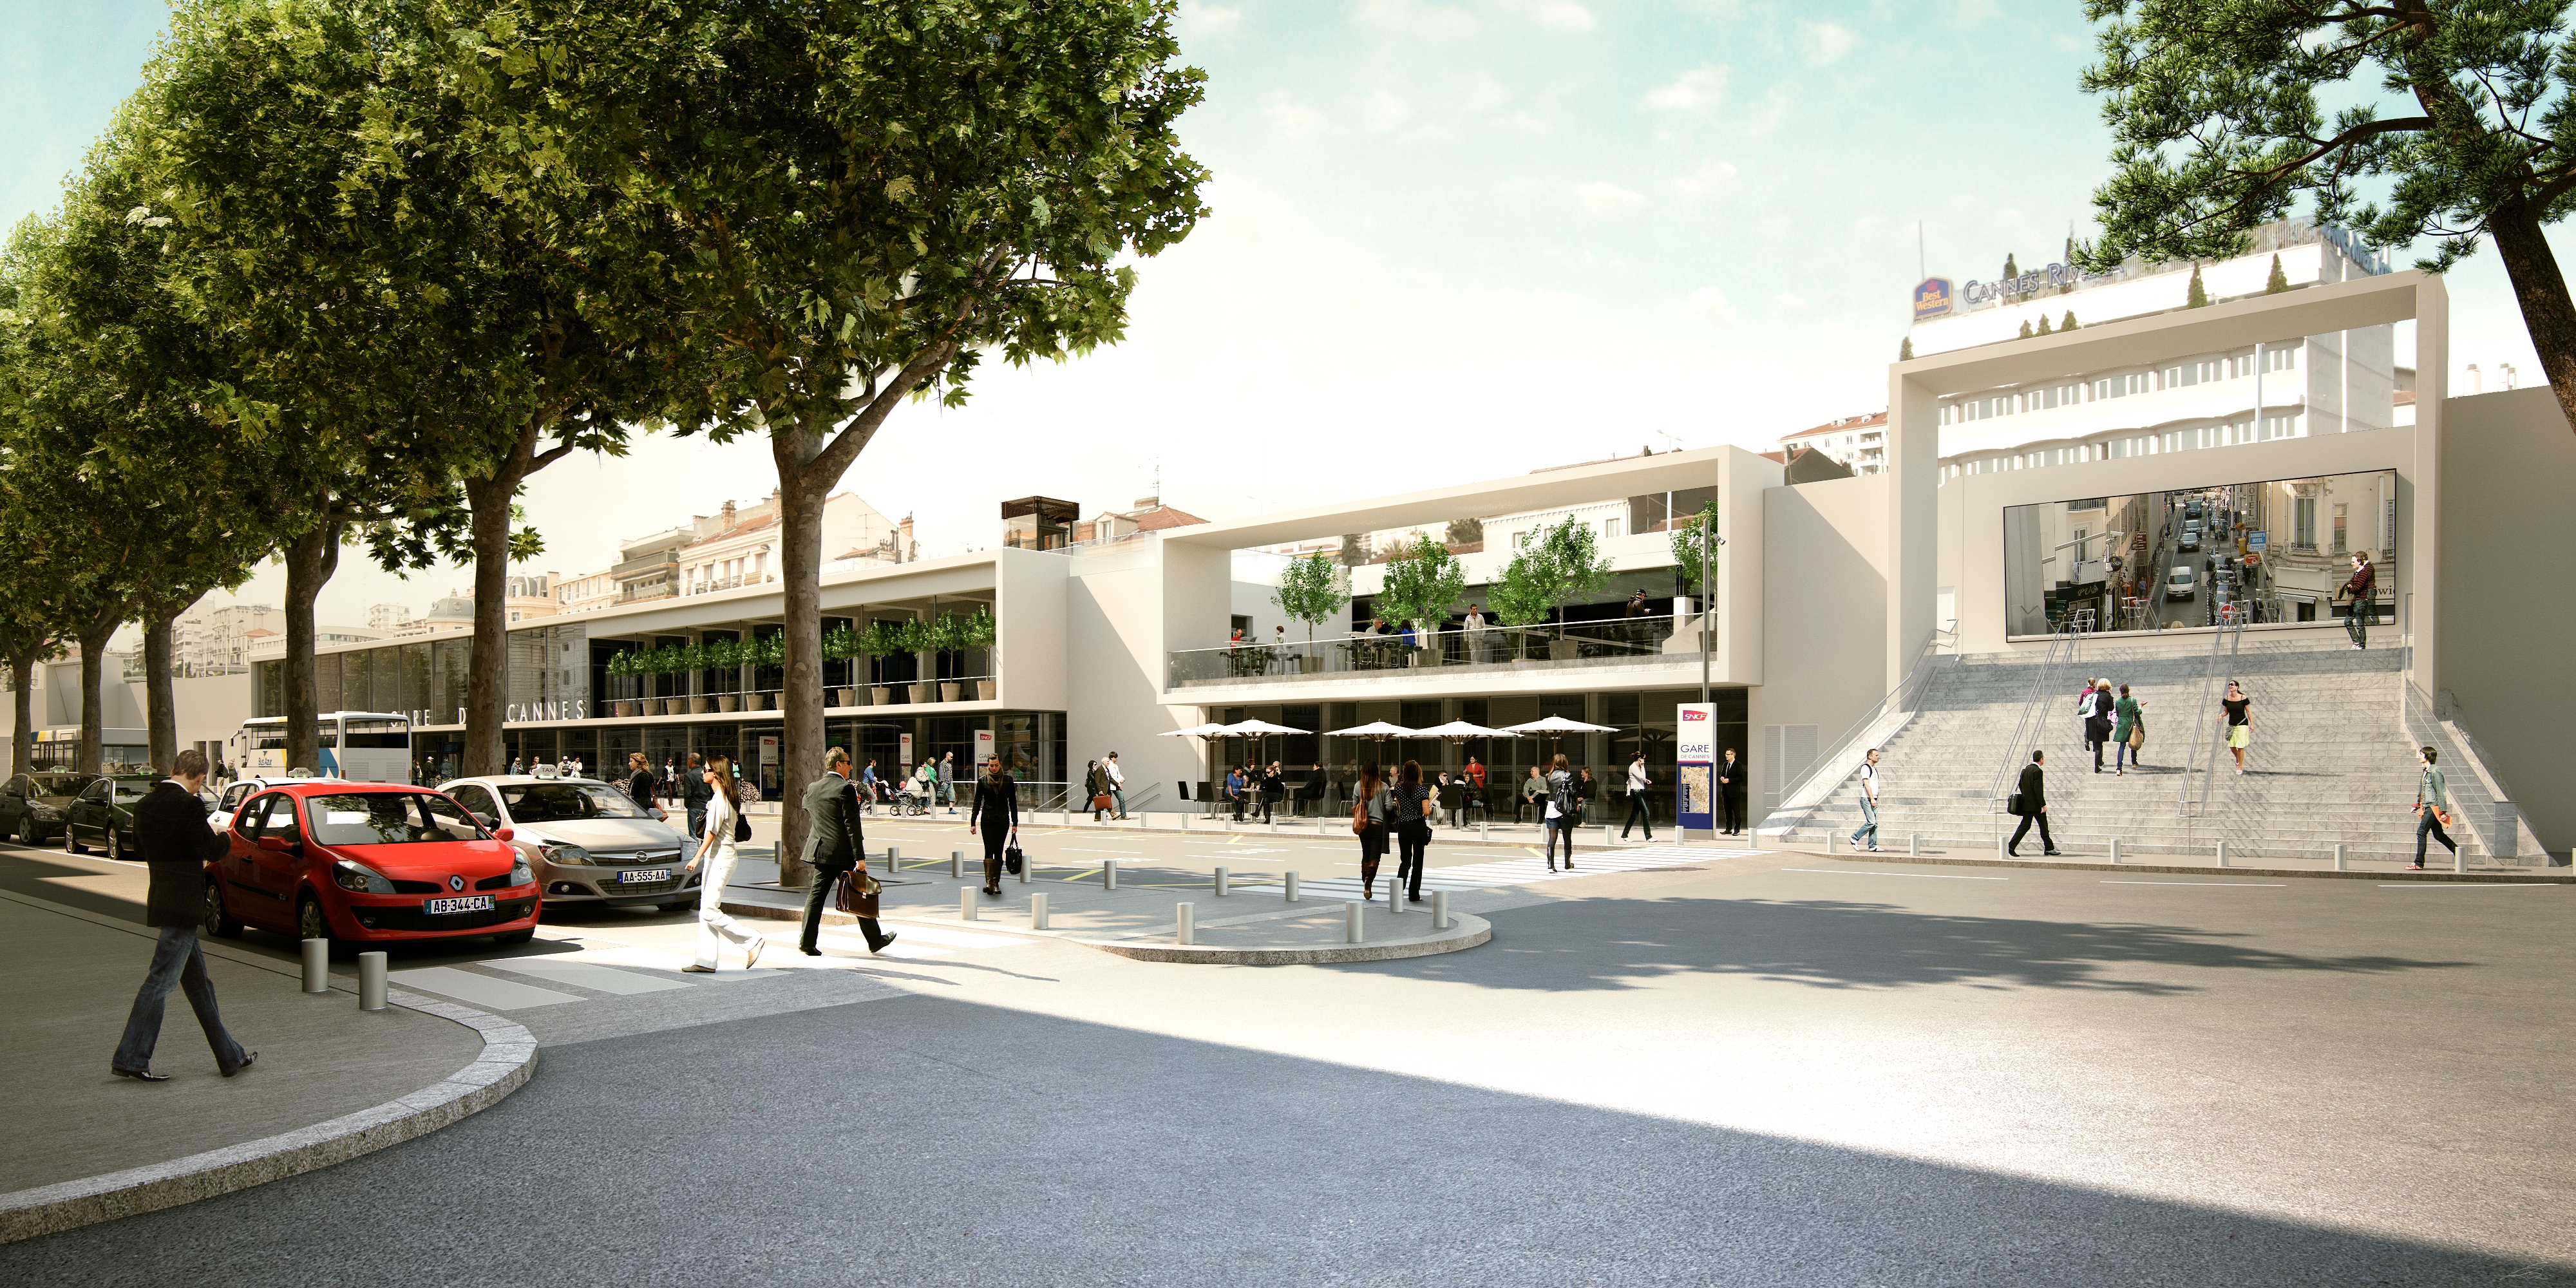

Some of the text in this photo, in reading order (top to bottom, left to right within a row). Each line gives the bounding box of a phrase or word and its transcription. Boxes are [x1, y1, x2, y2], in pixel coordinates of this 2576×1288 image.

[1922, 289, 1941, 302] Best
[1964, 273, 2040, 304] CANNES
[1915, 297, 1949, 312] Western
[507, 700, 585, 723] CANNES
[624, 871, 665, 882] AA-555-AA
[433, 897, 486, 913] AB-344-CA
